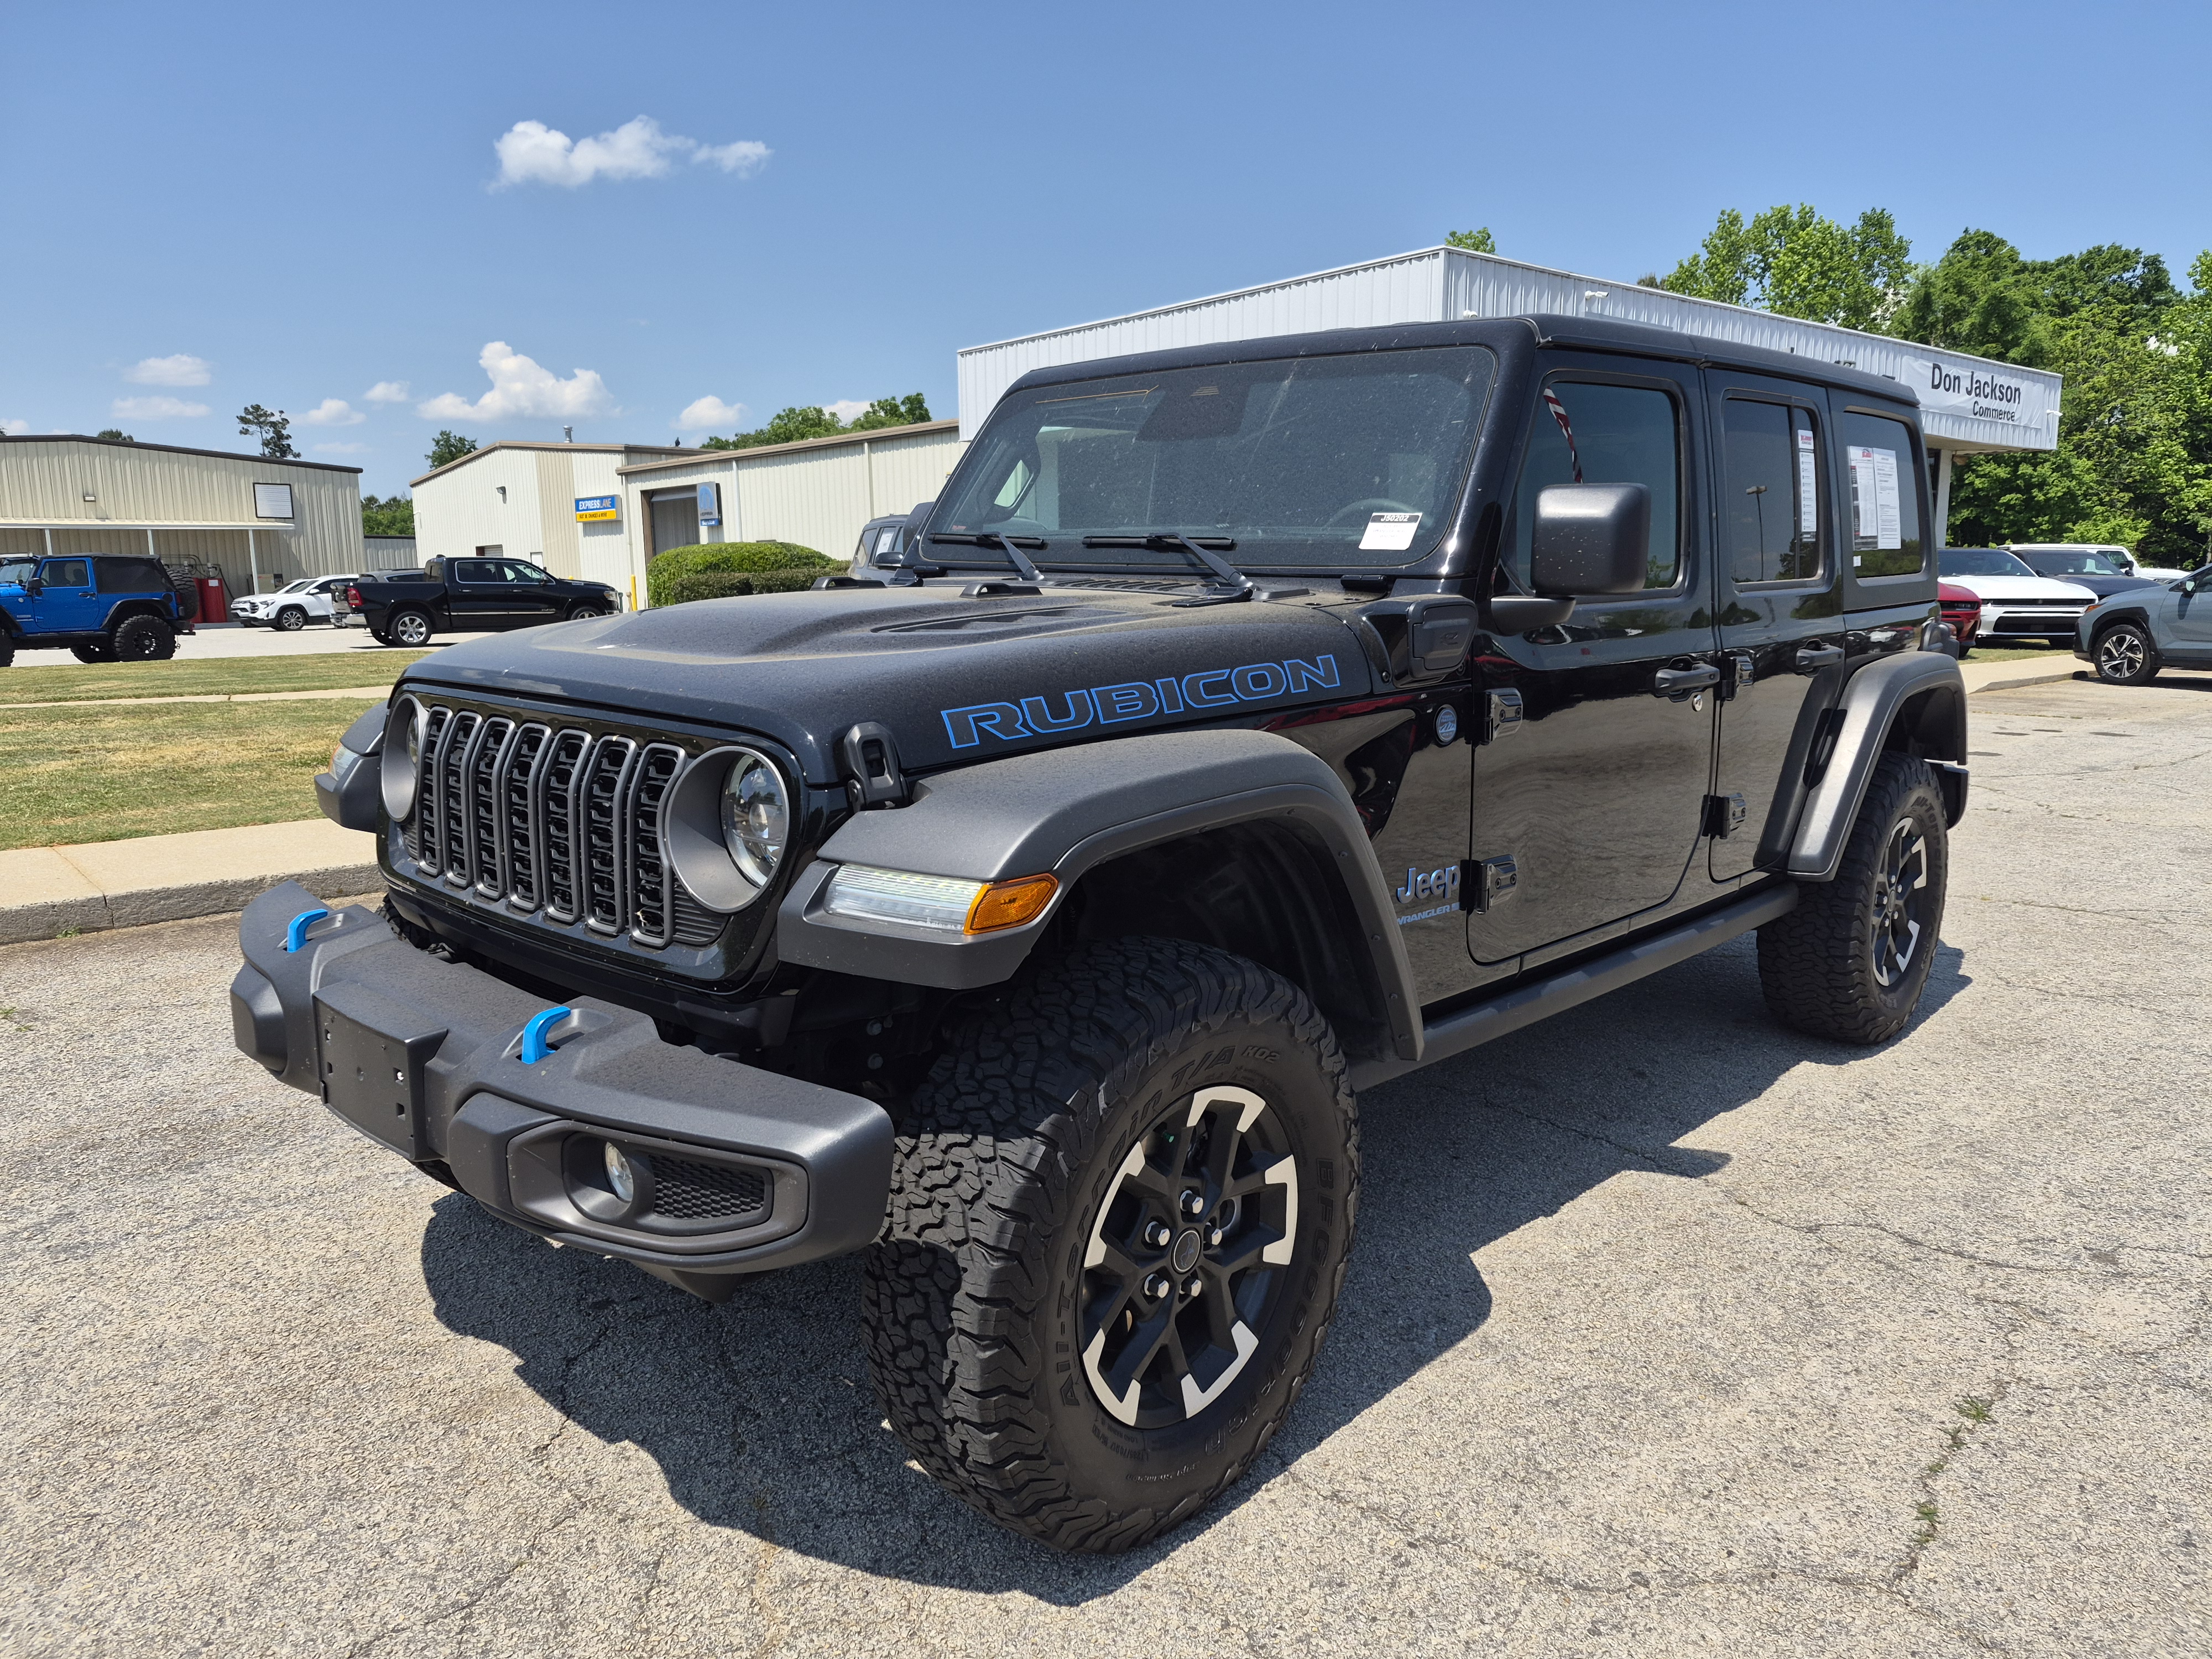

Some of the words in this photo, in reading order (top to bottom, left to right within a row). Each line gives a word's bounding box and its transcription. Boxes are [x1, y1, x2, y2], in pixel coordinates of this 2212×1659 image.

[1932, 363, 1960, 394] Don
[1966, 371, 2021, 404] Jackson
[1973, 400, 2015, 421] Commerce
[941, 654, 1340, 749] RUBICON
[1396, 865, 1460, 904] Jeep
[1172, 1046, 1236, 1092] T/A
[1242, 1045, 1280, 1064] KO2
